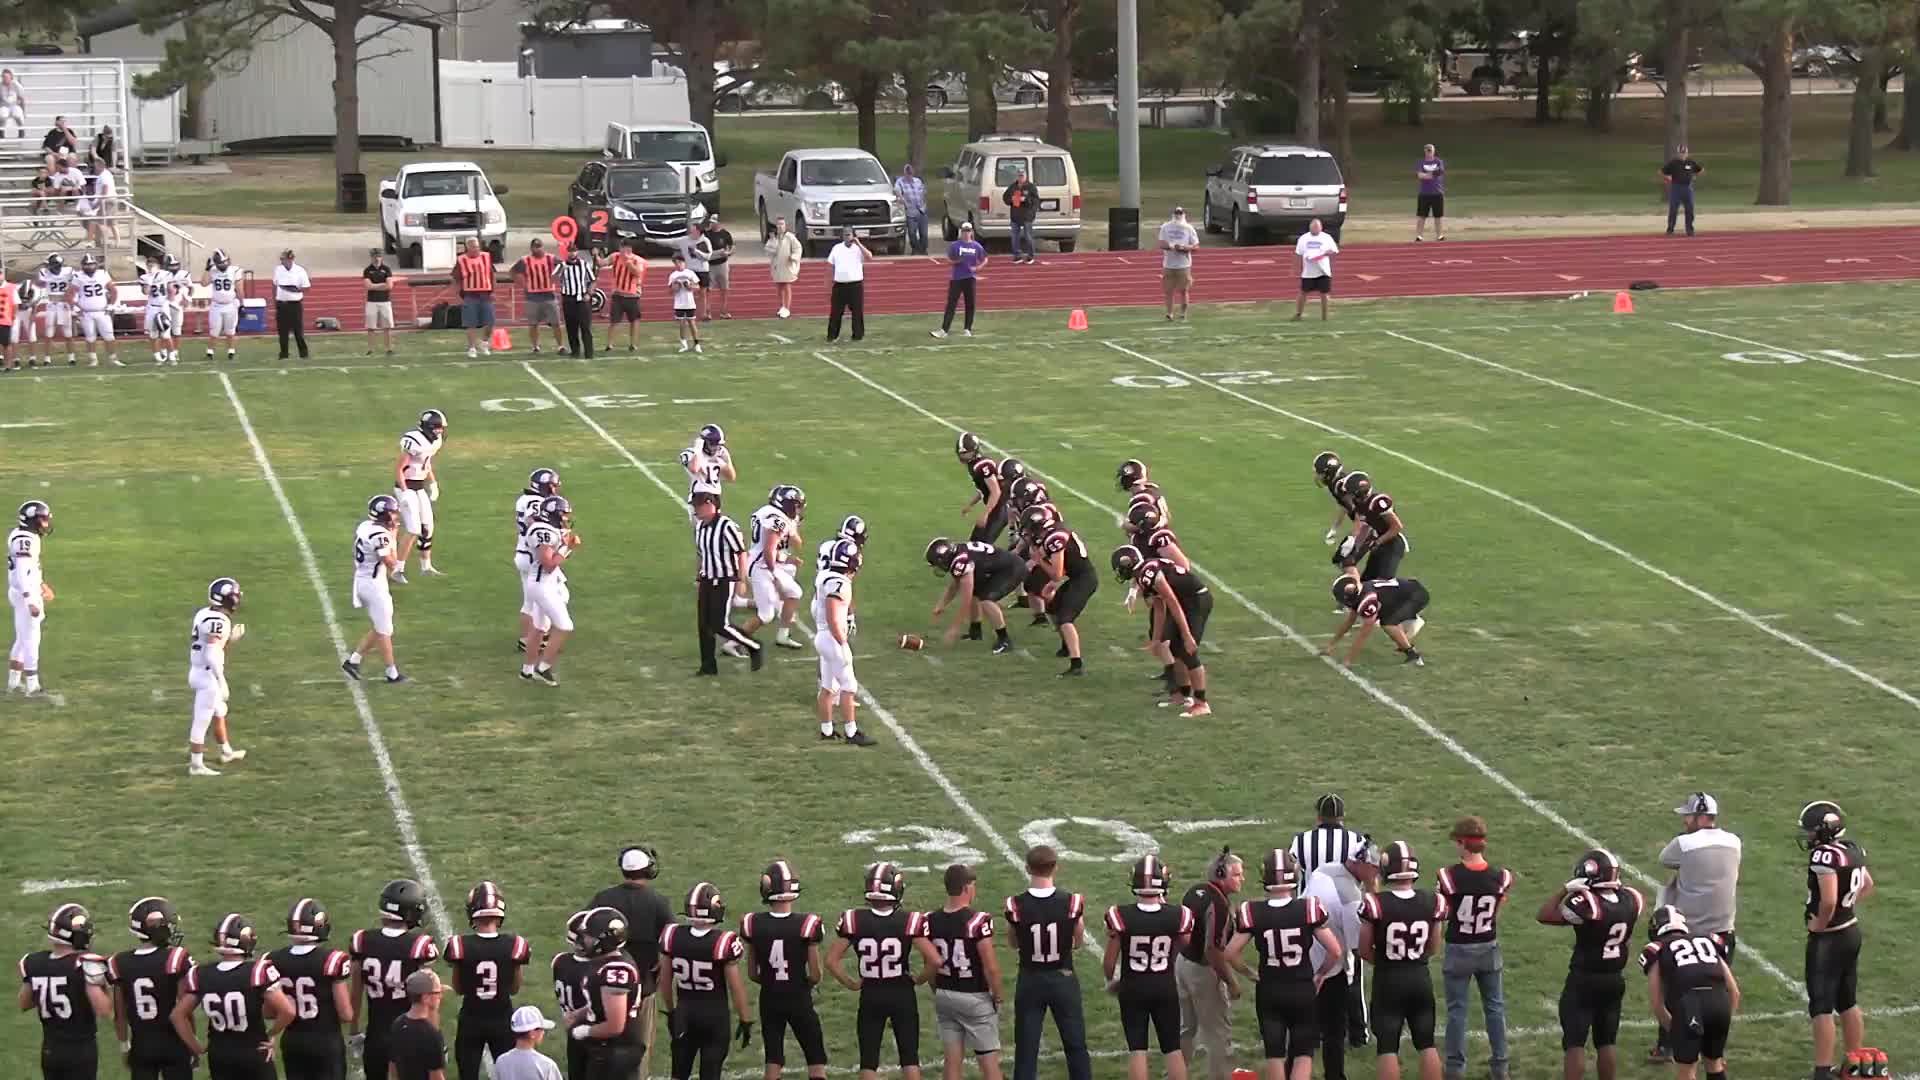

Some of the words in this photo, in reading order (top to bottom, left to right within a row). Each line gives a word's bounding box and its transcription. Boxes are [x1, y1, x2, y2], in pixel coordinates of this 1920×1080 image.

[590, 211, 608, 232] 2
[49, 282, 67, 293] 22
[83, 284, 104, 297] 52
[214, 279, 231, 292] 66
[706, 465, 722, 484] 13
[536, 531, 551, 545] 56
[209, 621, 221, 633] 12
[1812, 849, 1833, 865] 80
[1456, 895, 1497, 934] 42
[858, 938, 903, 979] 22
[934, 938, 974, 978] 24
[1030, 922, 1060, 962] 11
[1128, 935, 1172, 972] 58
[1262, 927, 1303, 966] 15
[1385, 921, 1429, 961] 63
[1602, 922, 1627, 959] 2
[1669, 937, 1718, 967] 20
[606, 970, 629, 985] 53
[672, 959, 713, 991] 25
[768, 939, 789, 981] 4
[31, 976, 72, 1019] 75
[362, 958, 406, 1000] 34
[476, 960, 498, 1000] 3
[133, 977, 159, 1020] 6
[203, 992, 249, 1032] 60
